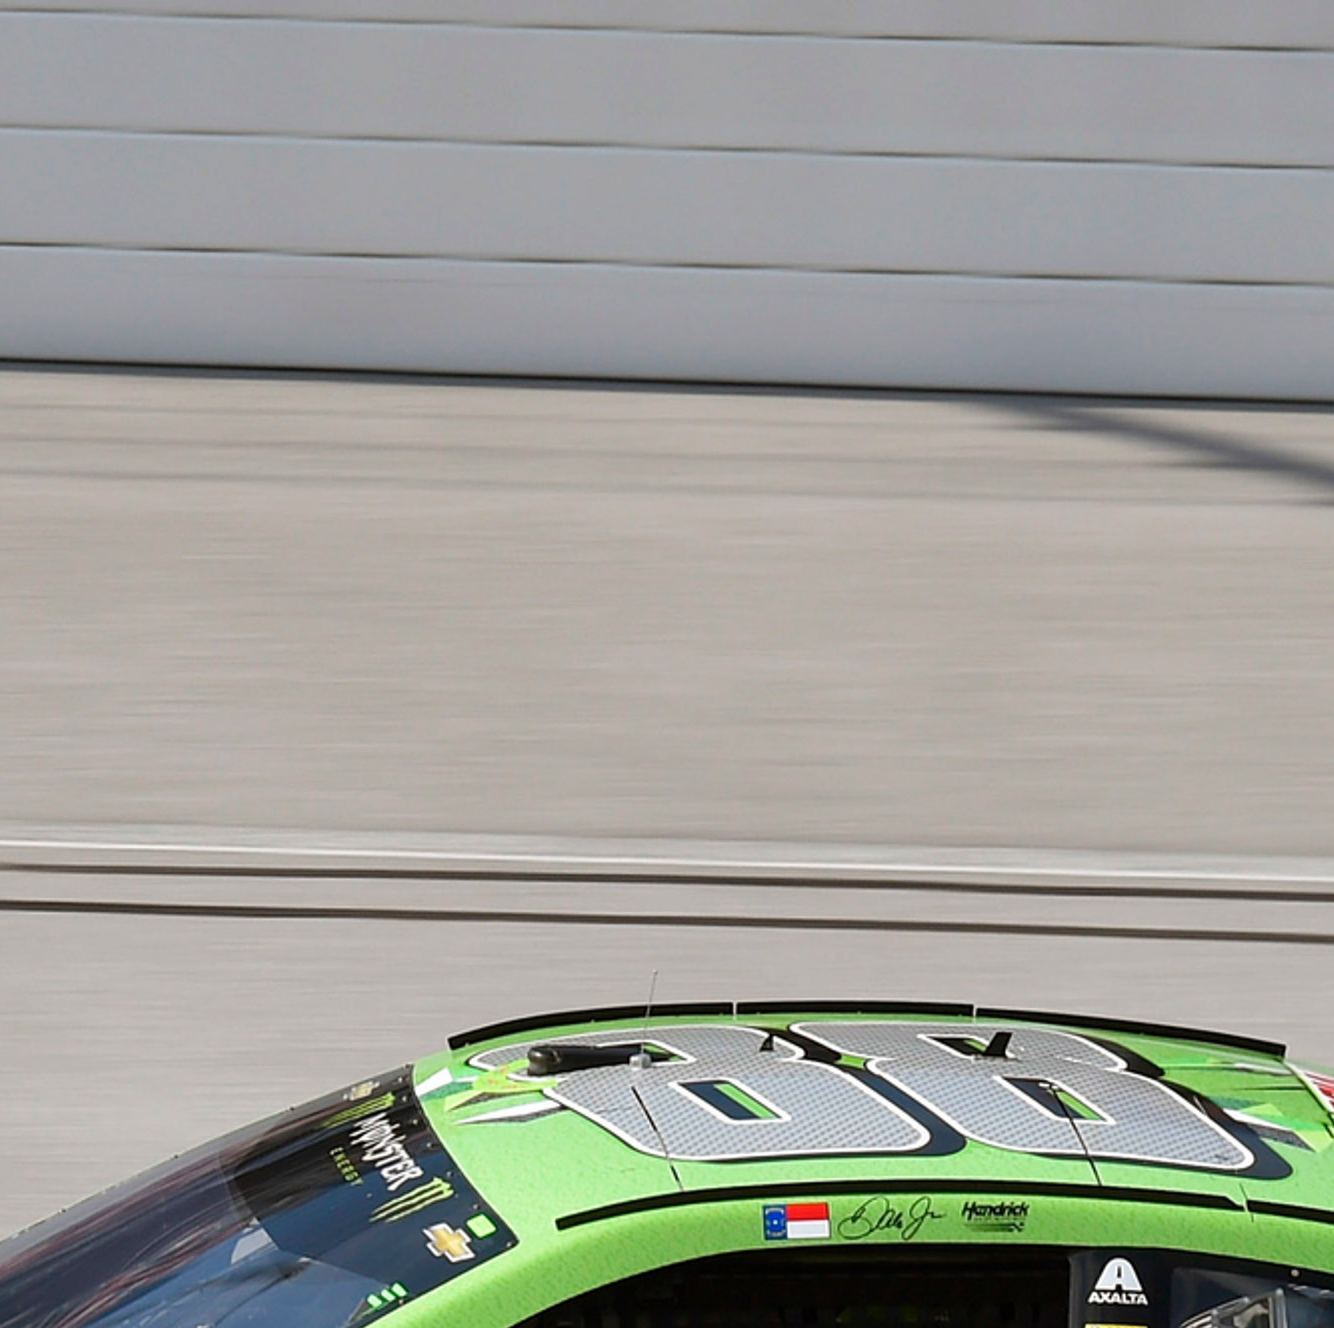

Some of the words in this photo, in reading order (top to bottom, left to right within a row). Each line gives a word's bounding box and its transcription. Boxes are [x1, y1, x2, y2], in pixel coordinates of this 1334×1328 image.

[468, 1022, 1255, 1170] 88
[961, 1200, 1031, 1220] Hendrick
[1087, 1291, 1148, 1306] AXALTA
